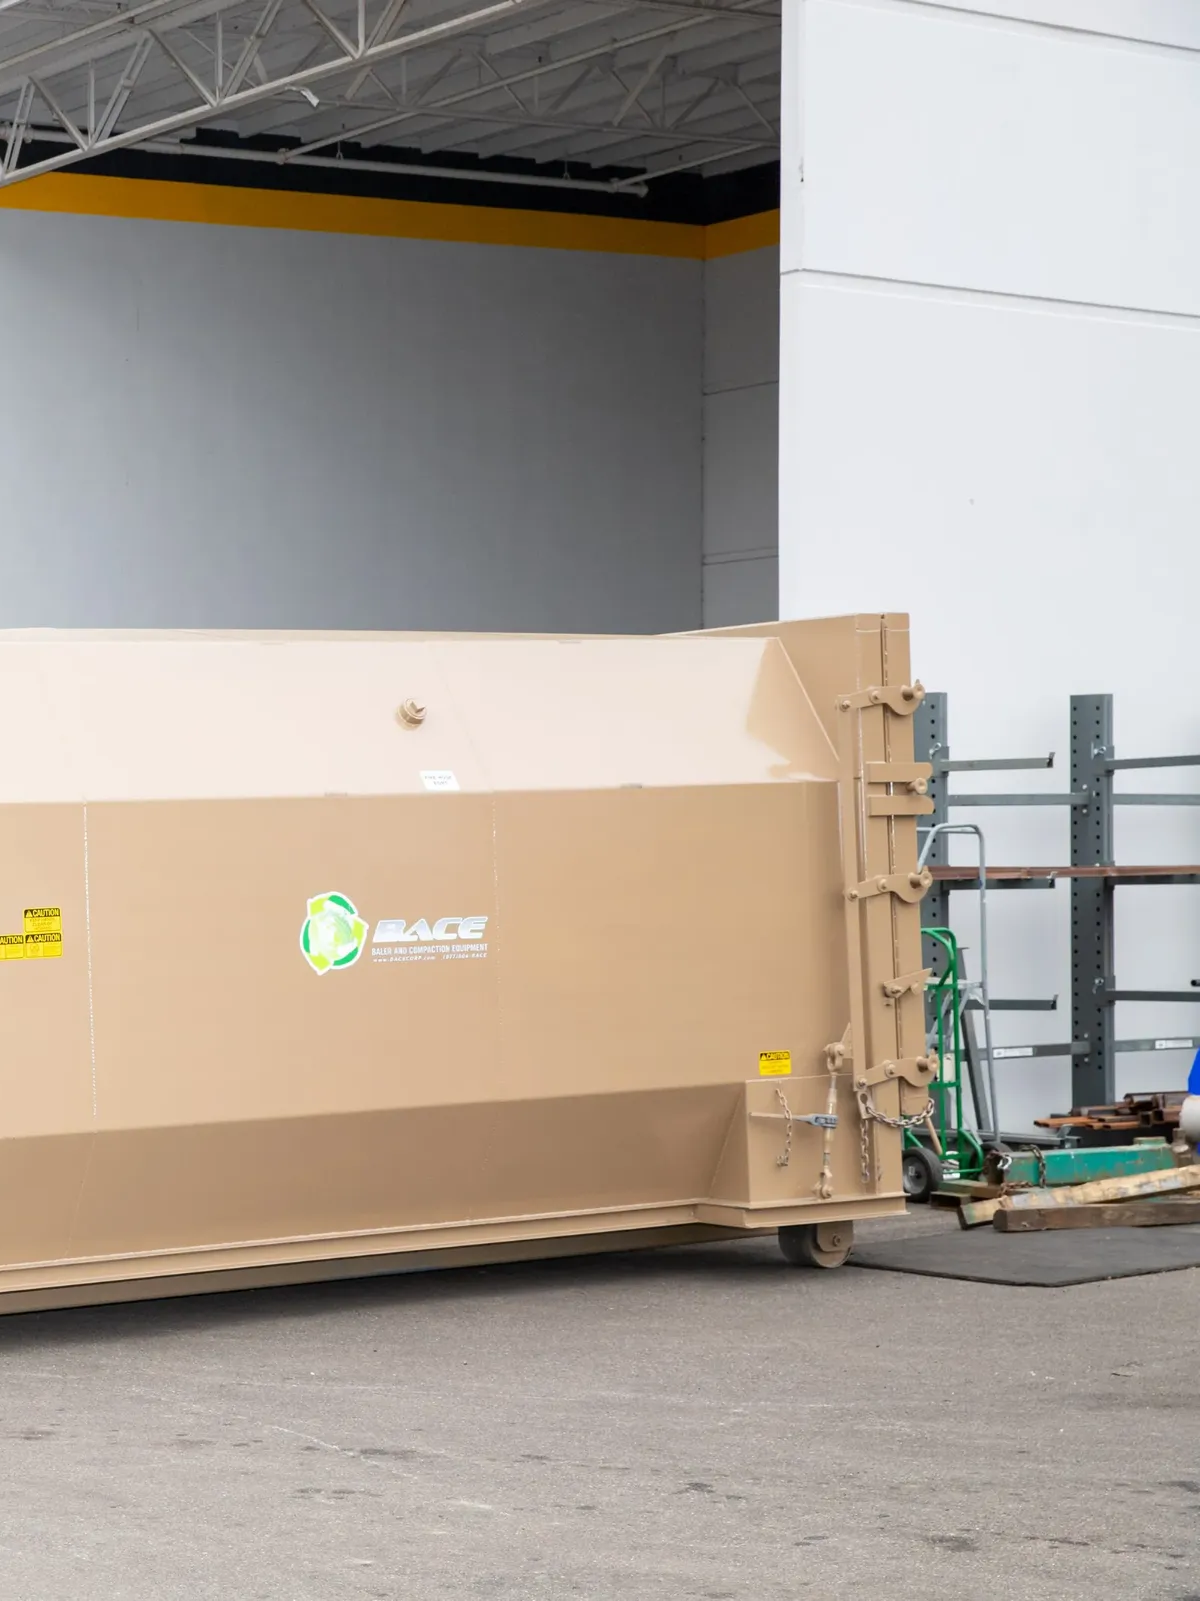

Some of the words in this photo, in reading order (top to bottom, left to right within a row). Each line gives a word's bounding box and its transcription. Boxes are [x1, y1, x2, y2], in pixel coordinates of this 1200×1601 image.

[32, 908, 59, 917] CAUTION
[372, 916, 488, 943] BACE
[33, 933, 60, 943] CAUTION
[371, 947, 392, 956] BALER
[393, 946, 408, 955] AND
[408, 944, 450, 954] COMPACTION
[451, 942, 488, 952] EQUIPMENT
